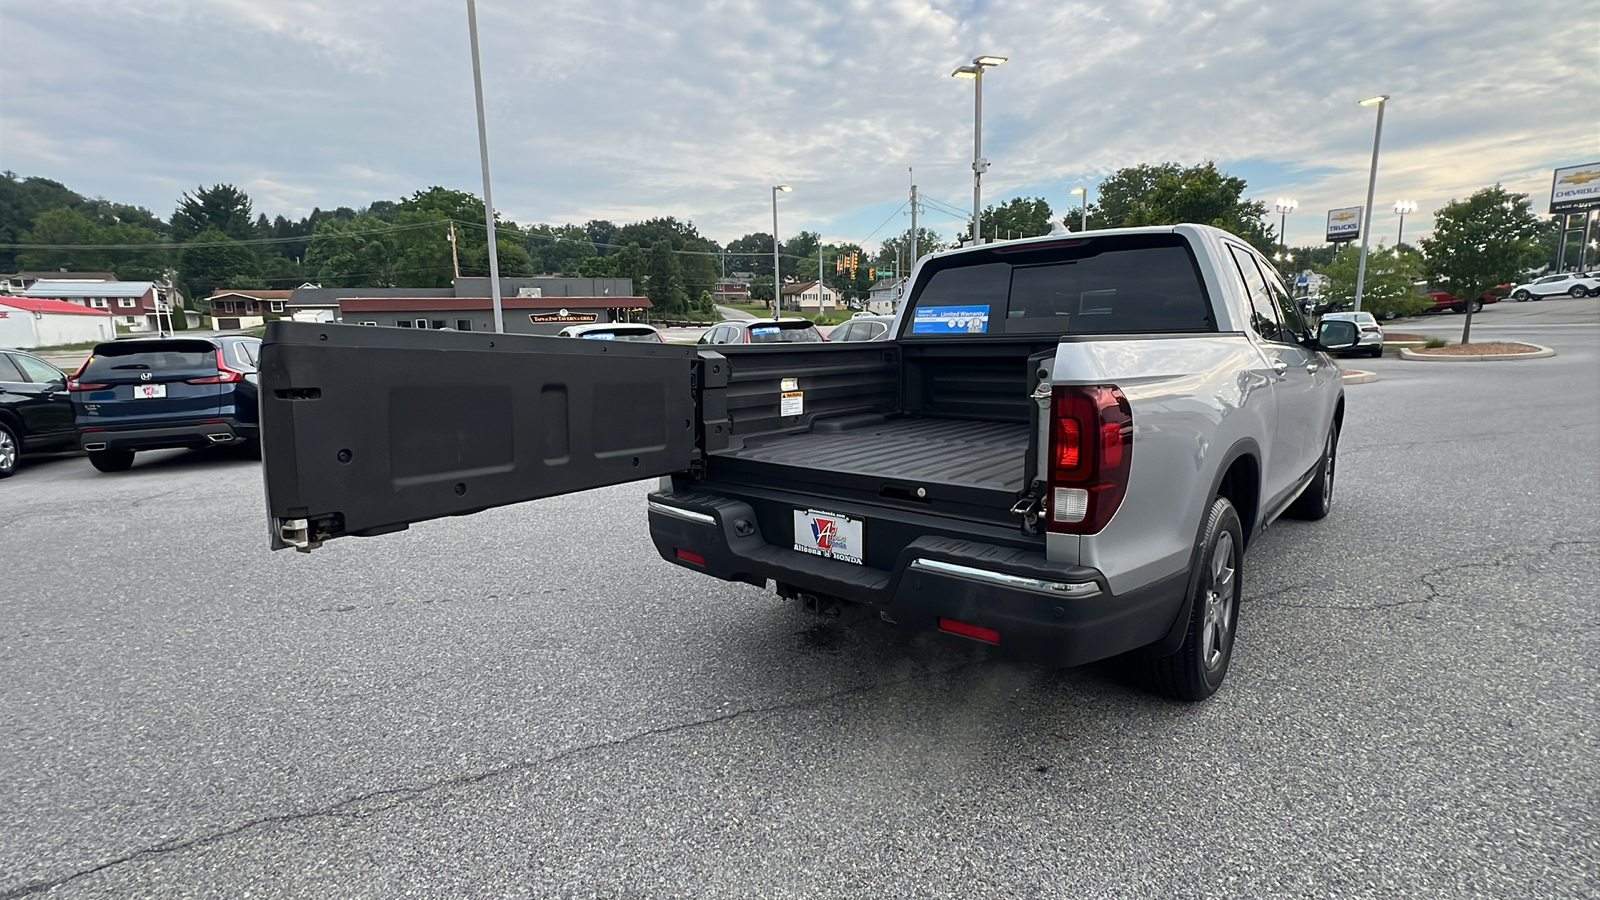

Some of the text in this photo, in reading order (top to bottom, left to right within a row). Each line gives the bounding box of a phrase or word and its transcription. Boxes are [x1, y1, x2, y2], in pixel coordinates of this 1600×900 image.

[1330, 223, 1357, 231] TRUCKS
[794, 543, 863, 565] Altoona HONDA
